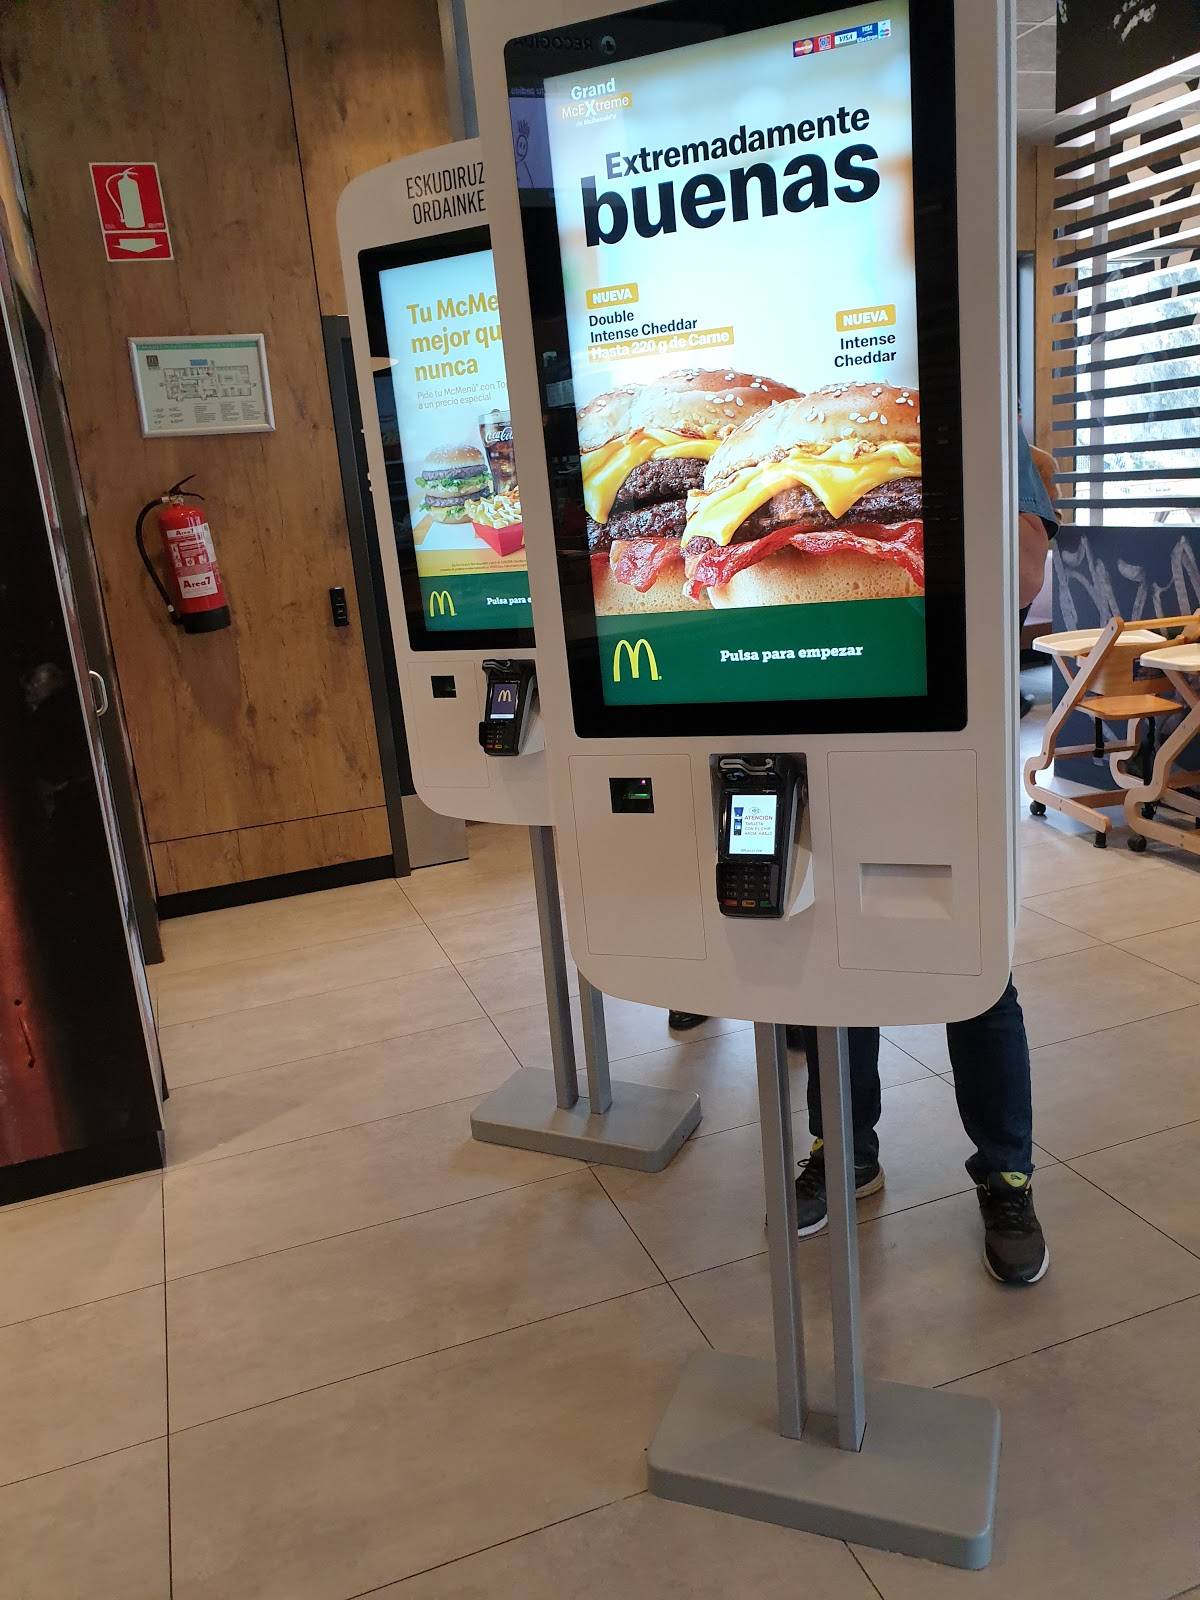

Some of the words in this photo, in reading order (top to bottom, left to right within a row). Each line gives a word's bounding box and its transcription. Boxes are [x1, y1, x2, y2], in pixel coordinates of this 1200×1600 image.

[570, 77, 616, 100] Grand
[606, 106, 870, 179] Extremadamente
[406, 162, 485, 199] ESKUDIRUZ
[581, 143, 880, 247] buenas
[412, 189, 486, 224] ORDAINKE
[592, 288, 633, 304] NUEVA
[406, 304, 432, 324] Tu
[589, 310, 634, 327] Double
[843, 309, 889, 327] NUEVA
[591, 327, 639, 343] Intense
[642, 318, 698, 335] Cheddar
[411, 327, 470, 356] mejor
[591, 344, 630, 360] Hasta
[670, 336, 688, 349] de
[688, 332, 730, 347] Carne
[840, 334, 896, 350] Intense
[415, 359, 479, 381] nunca
[834, 351, 897, 368] Cheddar
[183, 577, 211, 589] Area7
[486, 597, 508, 605] Pulsa
[509, 597, 527, 605] para
[720, 649, 759, 662] Pulsa
[762, 649, 795, 663] para
[798, 646, 863, 661] empezar
